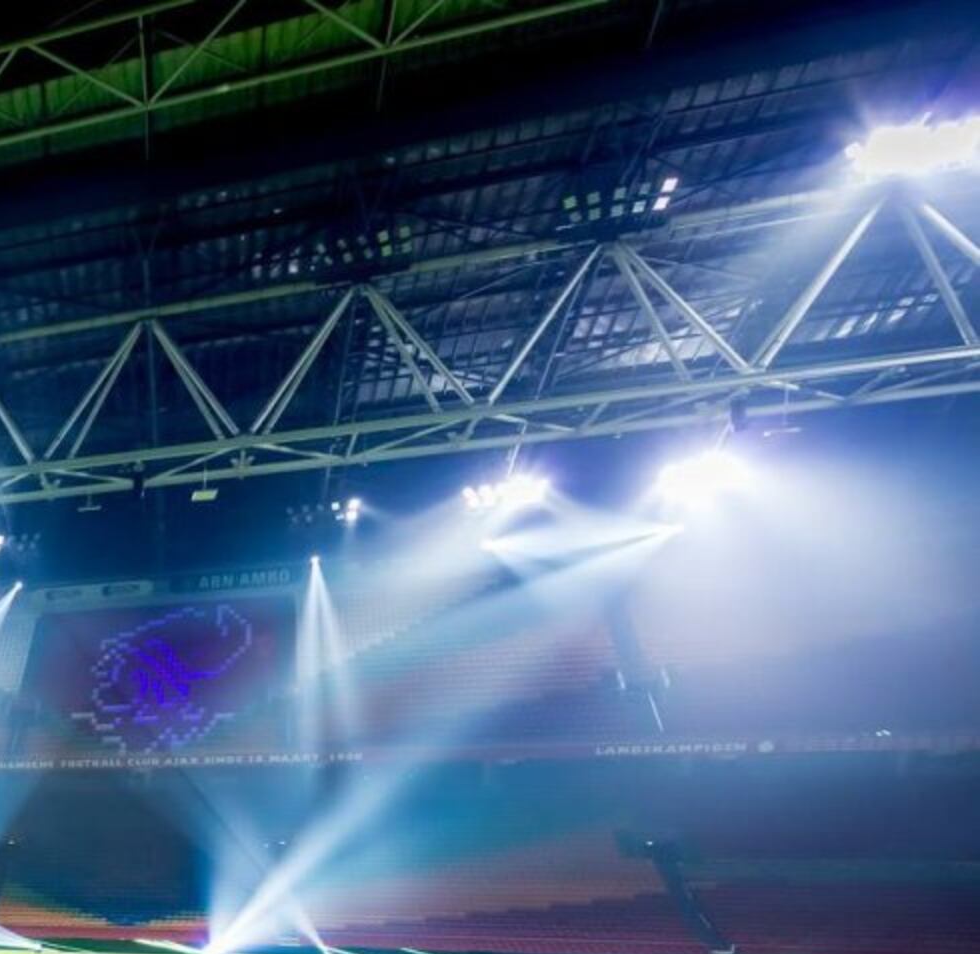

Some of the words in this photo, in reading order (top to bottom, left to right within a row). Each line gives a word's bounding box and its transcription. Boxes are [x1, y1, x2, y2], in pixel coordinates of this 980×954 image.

[198, 575, 234, 589] ABN
[239, 568, 291, 586] AMRO
[127, 757, 160, 767] CLUB
